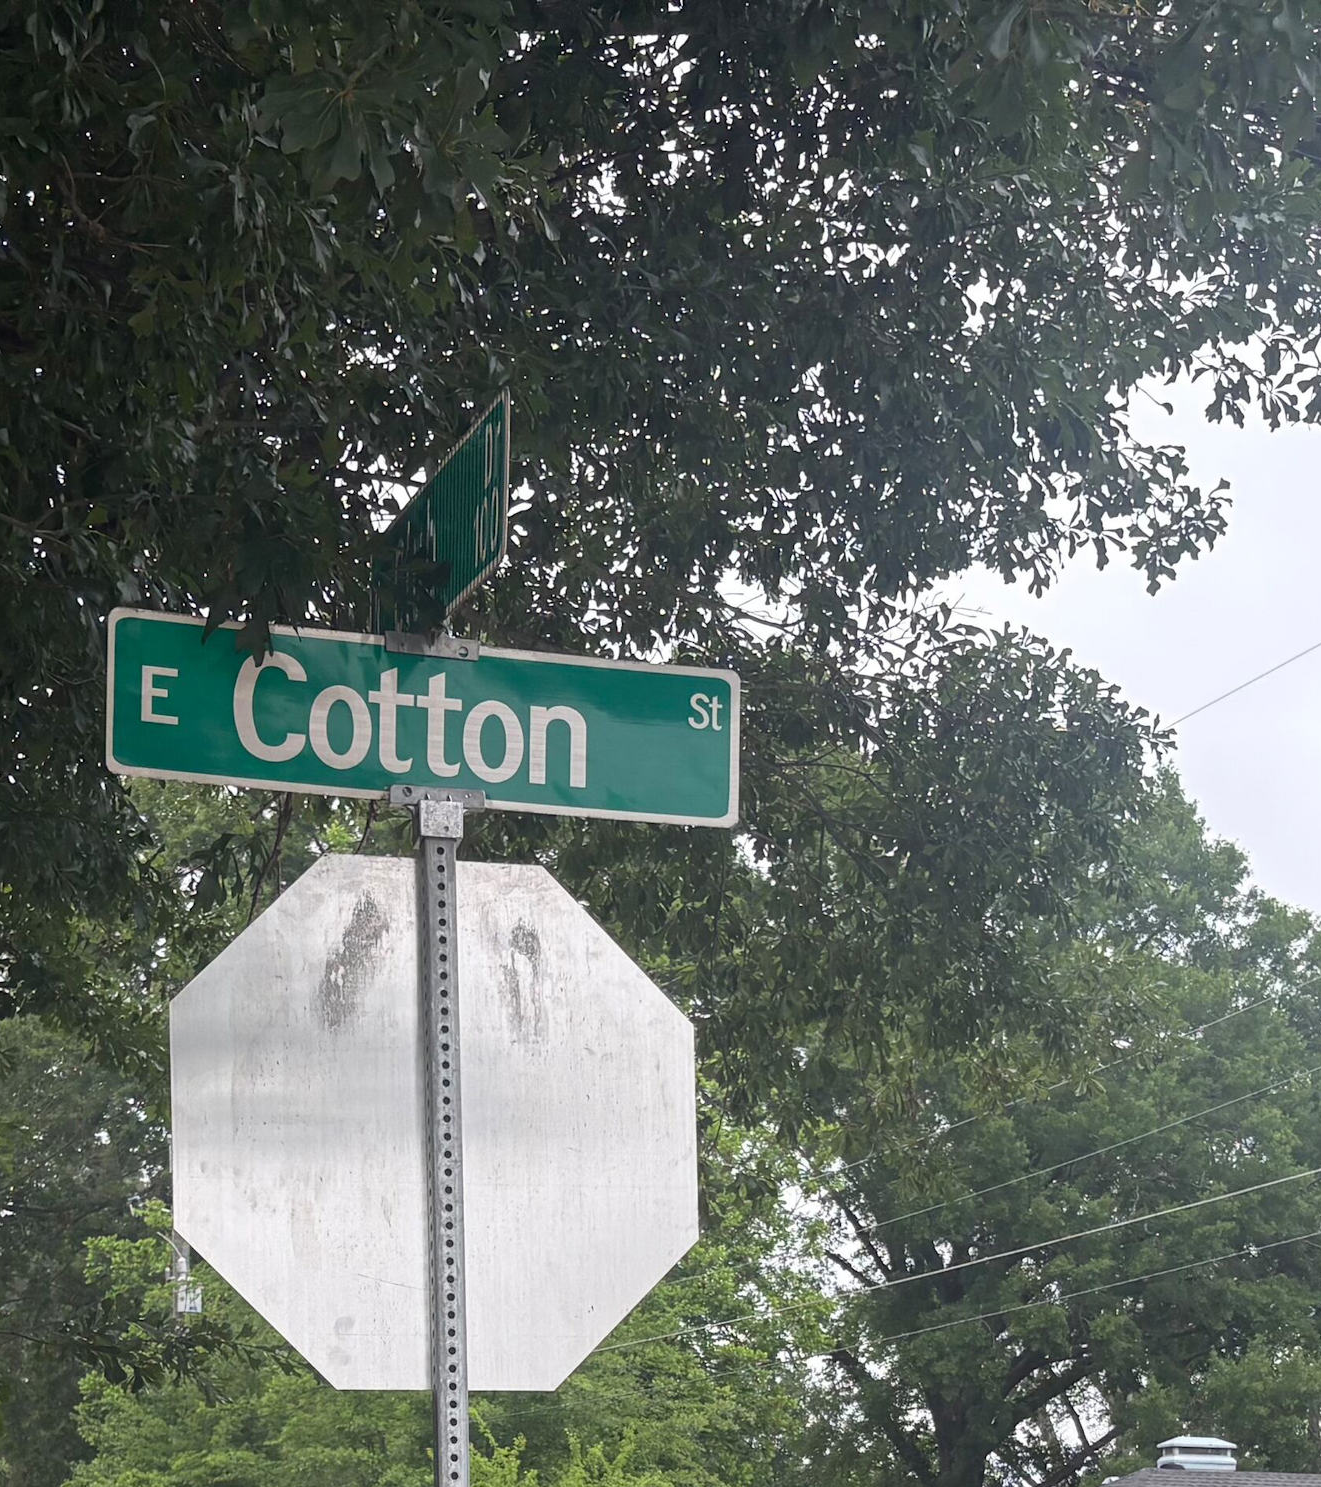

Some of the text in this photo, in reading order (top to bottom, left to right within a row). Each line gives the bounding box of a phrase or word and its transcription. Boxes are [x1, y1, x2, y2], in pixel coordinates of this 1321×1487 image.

[139, 651, 724, 789] E Cotton St
